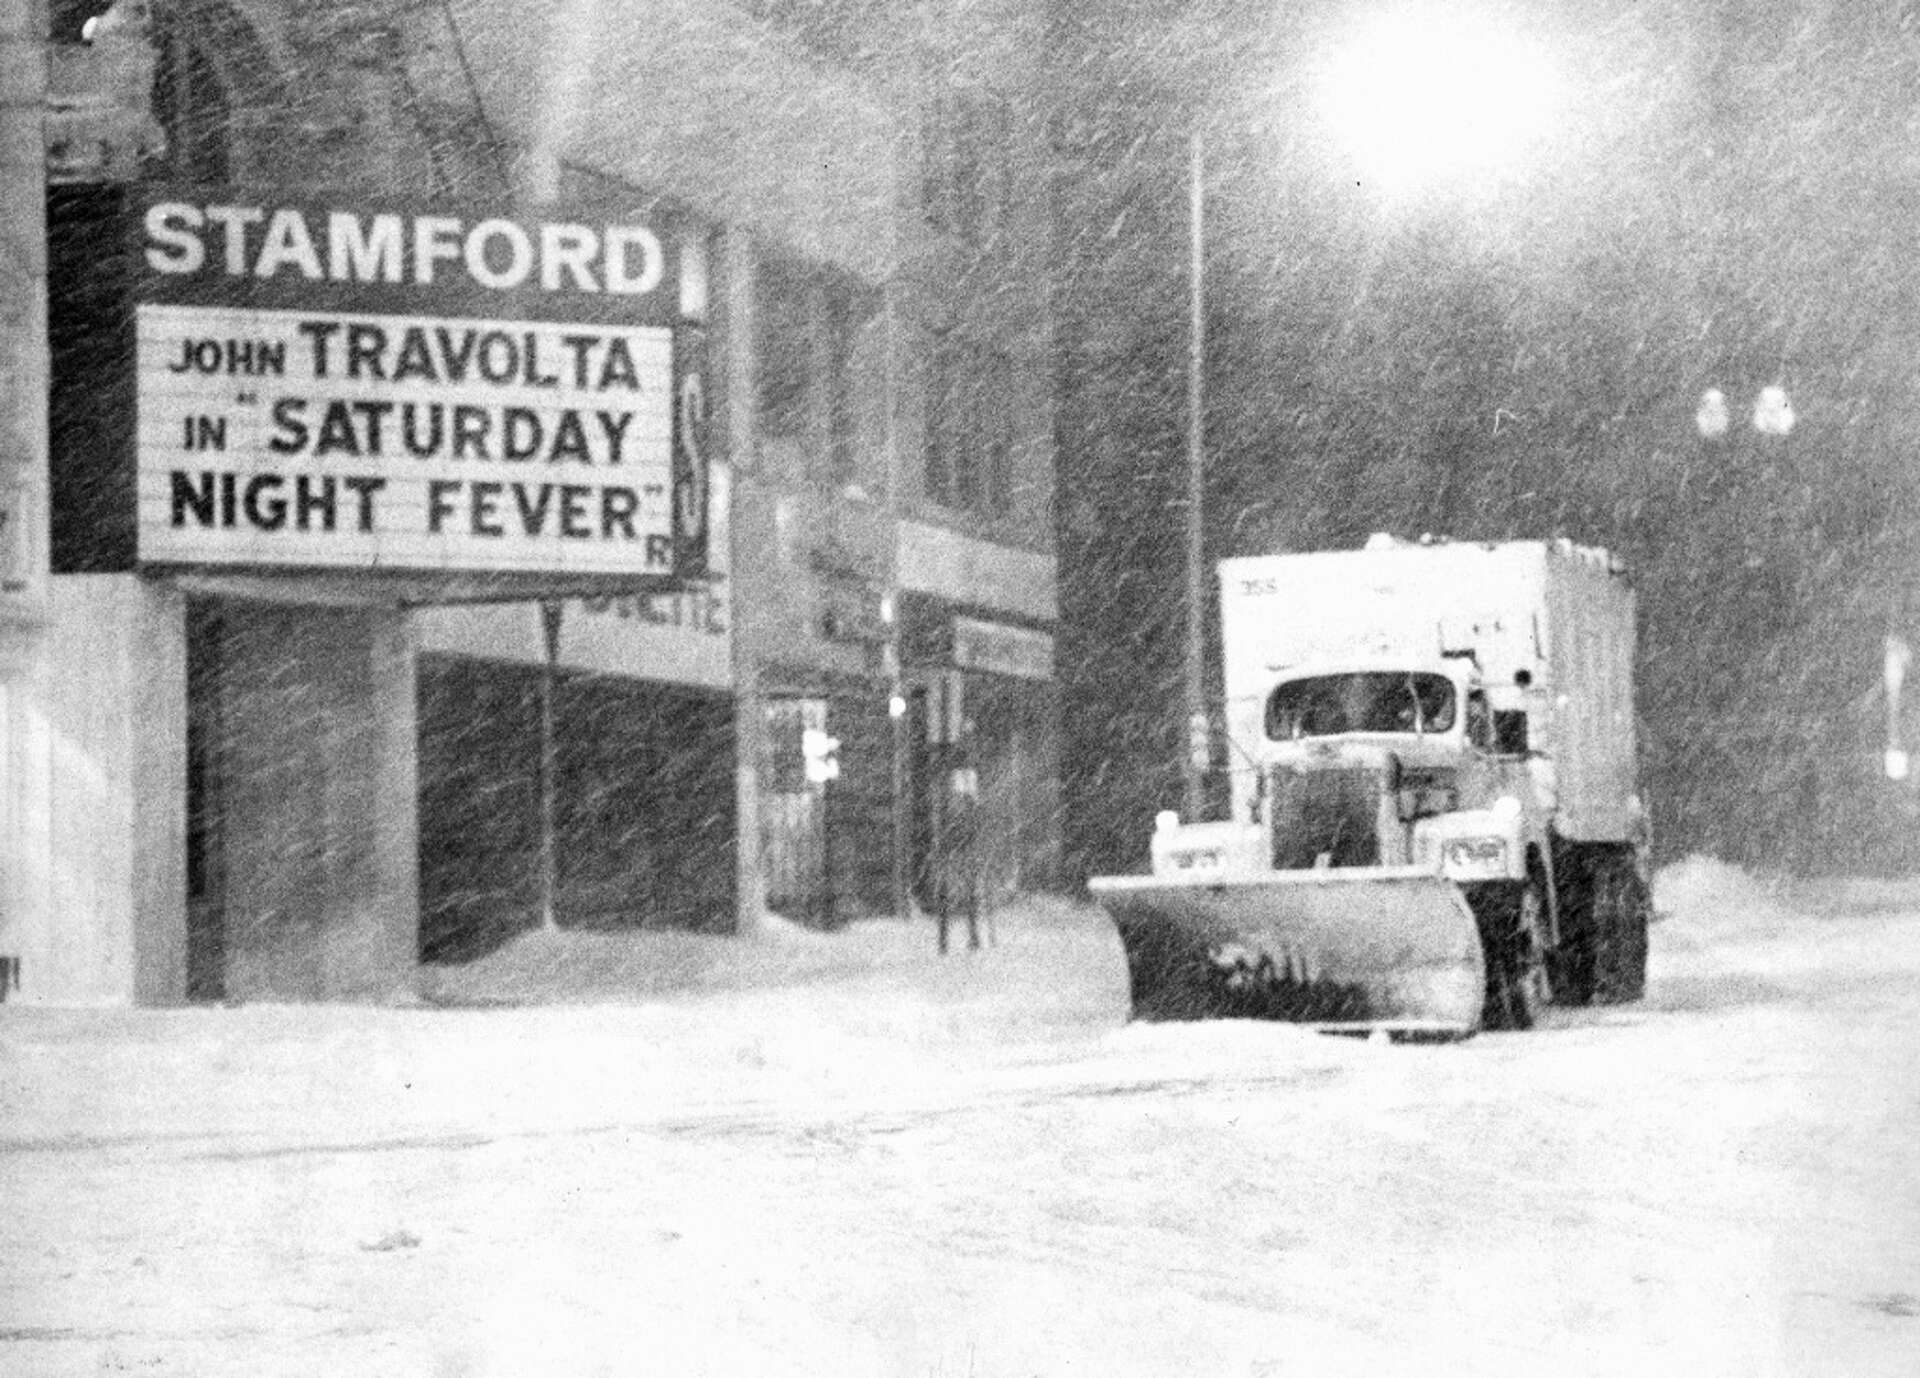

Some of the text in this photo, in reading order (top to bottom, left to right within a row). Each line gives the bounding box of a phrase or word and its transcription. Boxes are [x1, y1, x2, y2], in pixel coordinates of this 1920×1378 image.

[144, 202, 663, 295] STAMFORD
[168, 321, 641, 391] JOHN TRAVOLTA
[184, 414, 226, 451] IN
[171, 470, 386, 532] NIGHT
